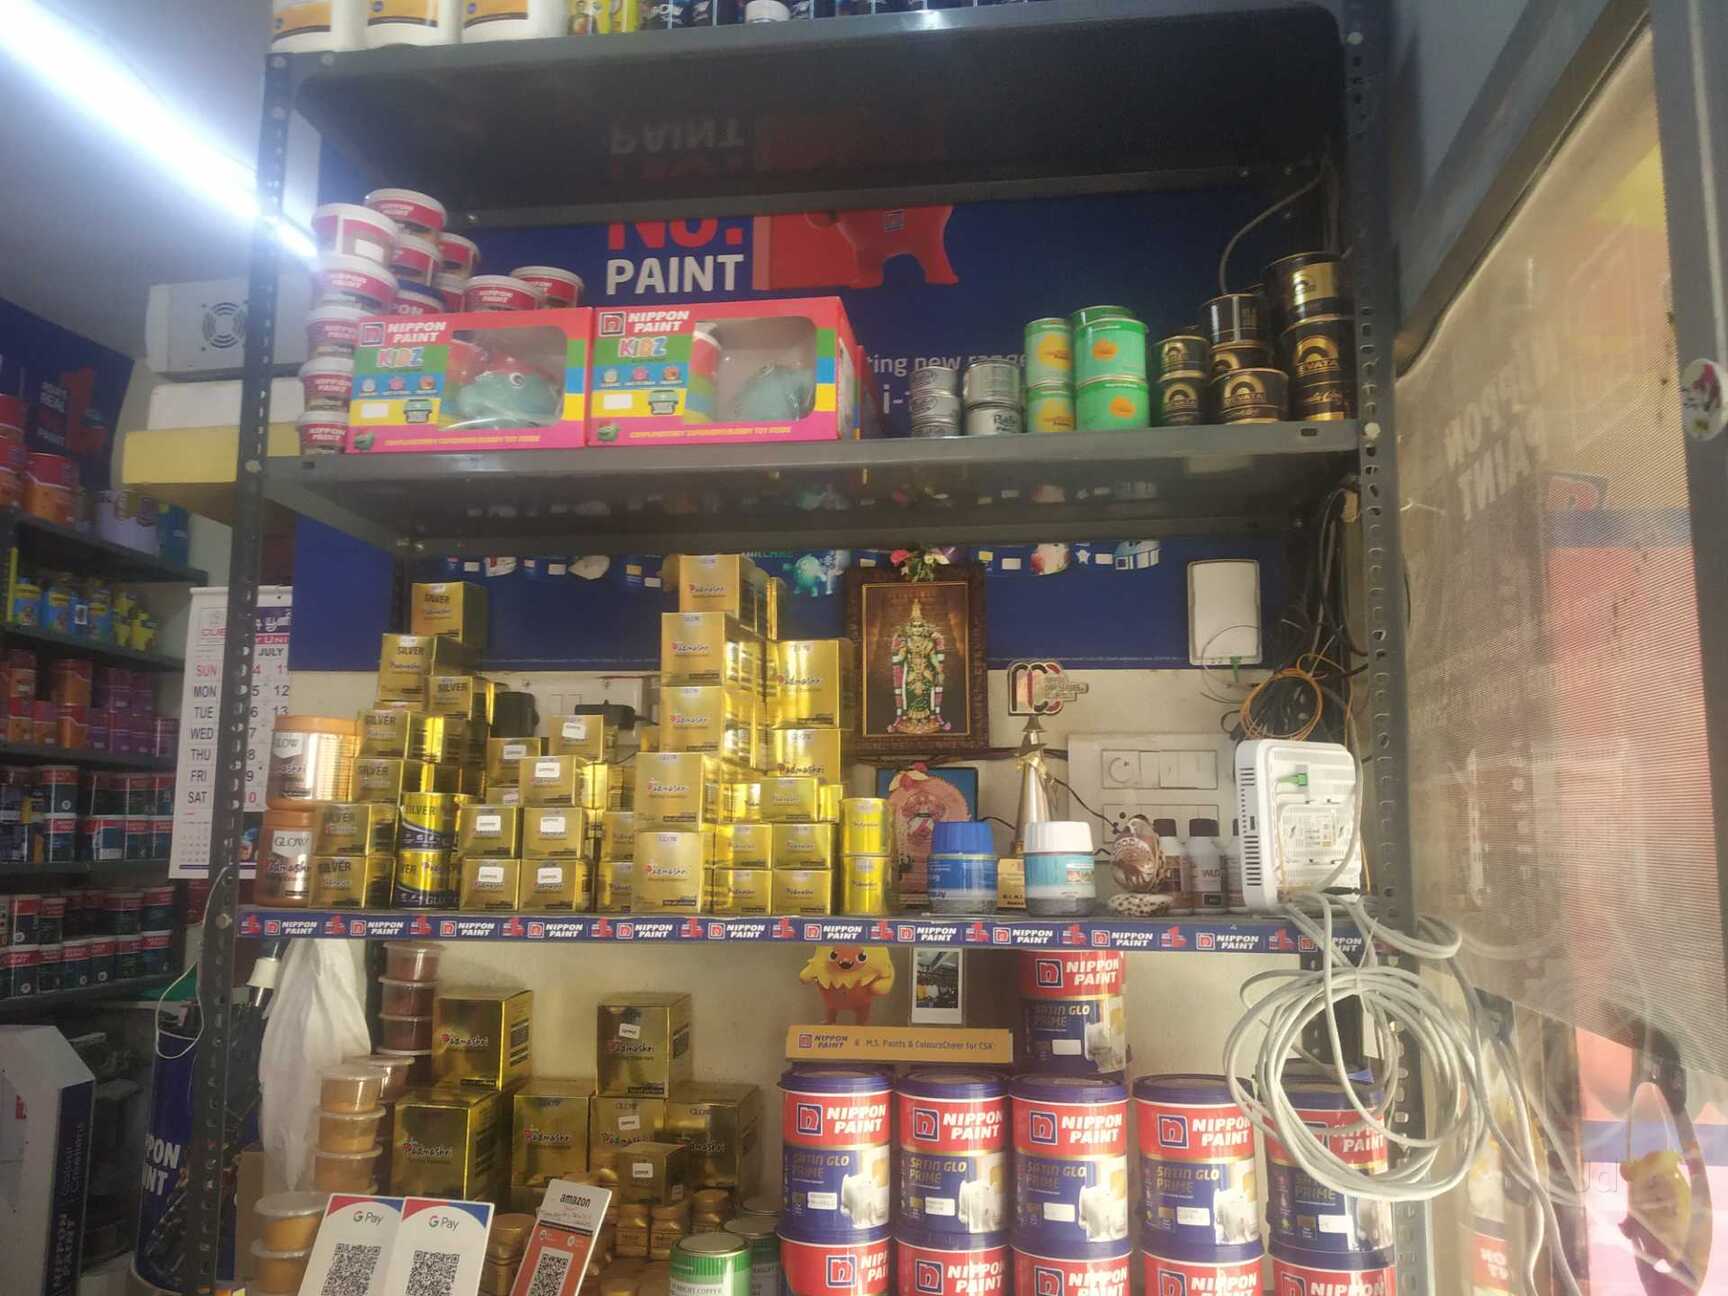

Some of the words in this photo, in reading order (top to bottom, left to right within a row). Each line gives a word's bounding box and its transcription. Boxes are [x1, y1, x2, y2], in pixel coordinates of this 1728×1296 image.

[606, 254, 744, 295] PAINT
[628, 310, 690, 323] NIPPON
[388, 321, 447, 333] NIPPON
[633, 320, 681, 334] PAINT
[393, 331, 441, 344] PAINT
[618, 336, 668, 358] KIDZ
[376, 347, 426, 369] KIDZ
[867, 354, 908, 377] ing
[914, 355, 961, 371] new
[258, 648, 284, 657] JULY
[397, 646, 425, 656] SILVER
[196, 664, 217, 677] SUN
[193, 686, 217, 698] MON
[252, 685, 260, 696] 5
[274, 685, 289, 696] 12
[193, 706, 214, 719] TUE
[250, 706, 258, 718] 6
[191, 728, 214, 739] WED
[249, 728, 257, 739] 7
[191, 748, 211, 761] THU
[247, 749, 256, 760] 8
[191, 770, 208, 782] FRI
[246, 770, 254, 782] 9
[188, 791, 208, 804] SAT
[248, 792, 256, 803] 0
[405, 805, 436, 816] SILVER
[275, 836, 309, 847] GLOW
[282, 921, 317, 929] NIPPON
[368, 921, 404, 930] NIPPON
[458, 922, 495, 930] NIPPON
[546, 923, 583, 932] NIPPON
[635, 923, 673, 932] NIPPON
[726, 923, 766, 932] NIPPON
[823, 924, 863, 933] NIPPON
[917, 926, 957, 935] NIPPON
[461, 928, 492, 936] PAINT
[549, 930, 580, 938] PAINT
[639, 930, 669, 938] PAINT
[731, 930, 762, 938] PAINT
[826, 931, 859, 940] PAINT
[921, 933, 953, 941] PAINT
[1012, 928, 1053, 937] NIPPON
[1111, 931, 1153, 940] NIPPON
[1017, 935, 1050, 943] PAINT
[1116, 938, 1150, 946] PAINT
[1216, 934, 1259, 943] NIPPON
[1221, 941, 1255, 949] PAINT
[1066, 959, 1119, 974] NIPPON
[1074, 972, 1117, 986] PAINT
[1069, 1005, 1090, 1015] GLO
[814, 1034, 848, 1042] NIPPON
[818, 1041, 844, 1049] PAINT
[827, 1104, 886, 1120] NIPPON
[944, 1111, 1002, 1127] NIPPON
[1062, 1114, 1122, 1130] NIPPON
[1193, 1116, 1251, 1133] NIPPON
[835, 1118, 882, 1134] PAINT
[951, 1125, 1000, 1140] PAINT
[1070, 1128, 1118, 1144] PAINT
[1201, 1131, 1248, 1146] PAINT
[1343, 1135, 1386, 1153] PAINT
[827, 1155, 849, 1166] GLO
[944, 1161, 967, 1172] GLO
[1063, 1166, 1087, 1178] GLO
[1196, 1168, 1220, 1181] GLO
[560, 1191, 592, 1209] amazon
[364, 1213, 383, 1226] Pay
[441, 1216, 460, 1231] Pay
[1069, 1267, 1128, 1286] NIPPON
[1192, 1273, 1258, 1291] NIPPON
[1078, 1283, 1125, 1296] PAINT
[1311, 1281, 1386, 1296] NIPPON
